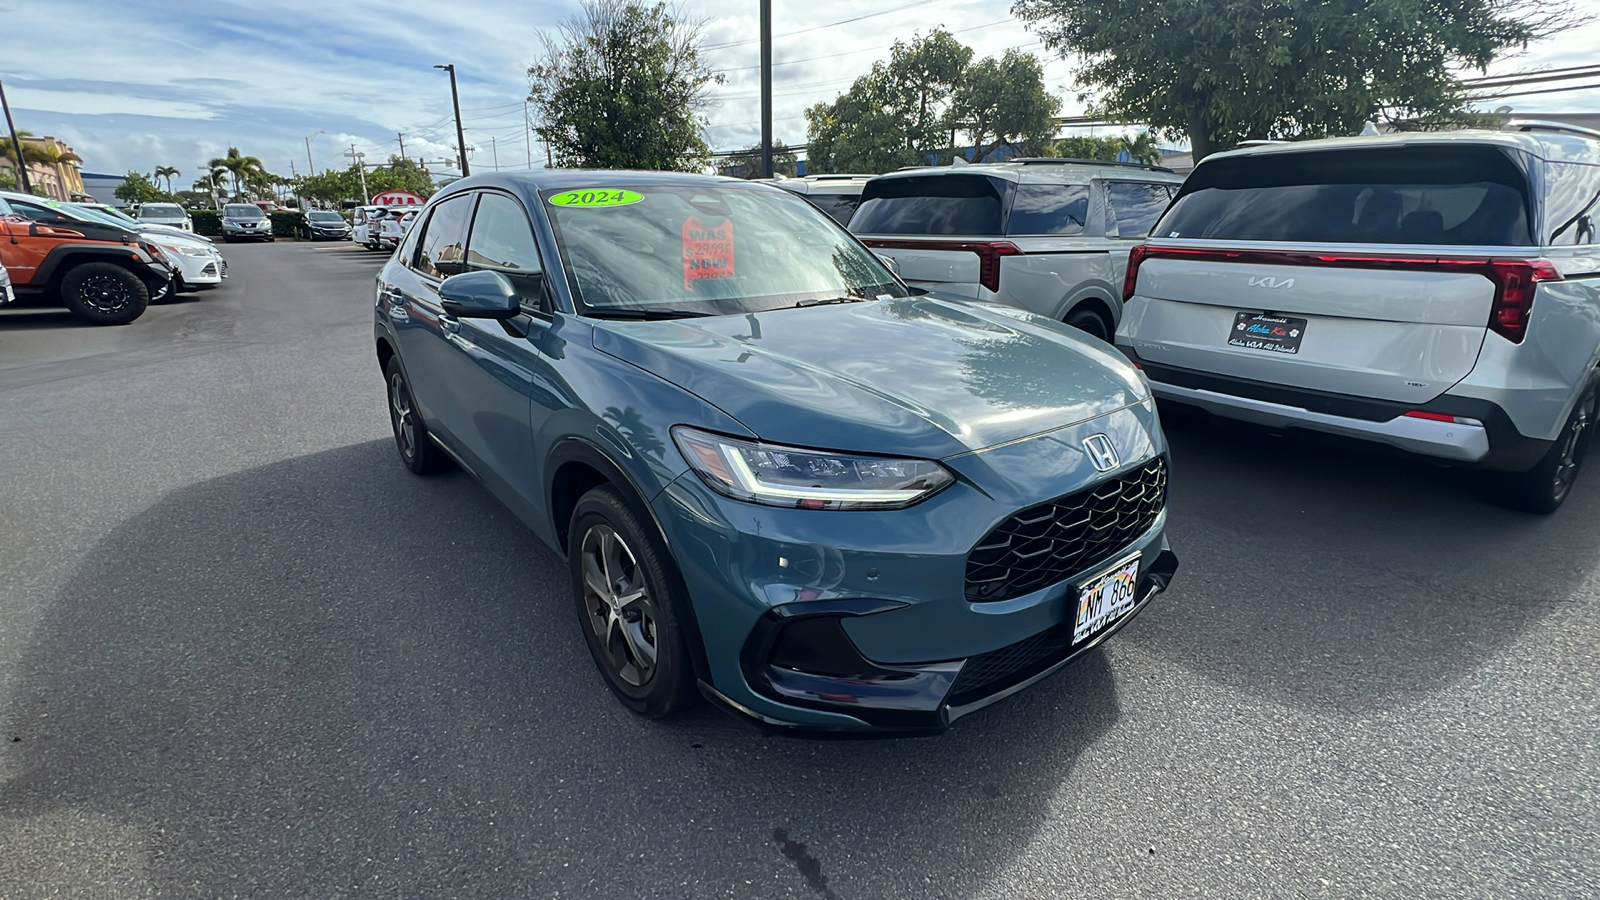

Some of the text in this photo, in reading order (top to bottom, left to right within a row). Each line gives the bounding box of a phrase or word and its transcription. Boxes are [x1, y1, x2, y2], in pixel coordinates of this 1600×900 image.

[381, 197, 416, 205] KIA
[566, 191, 624, 204] 2024
[689, 229, 726, 241] WAS
[690, 258, 727, 269] NOW
[1252, 315, 1287, 323] Hawaii
[1246, 323, 1287, 336] Aloha Kia
[1077, 587, 1104, 627] LNM
[1110, 570, 1135, 605] 866
